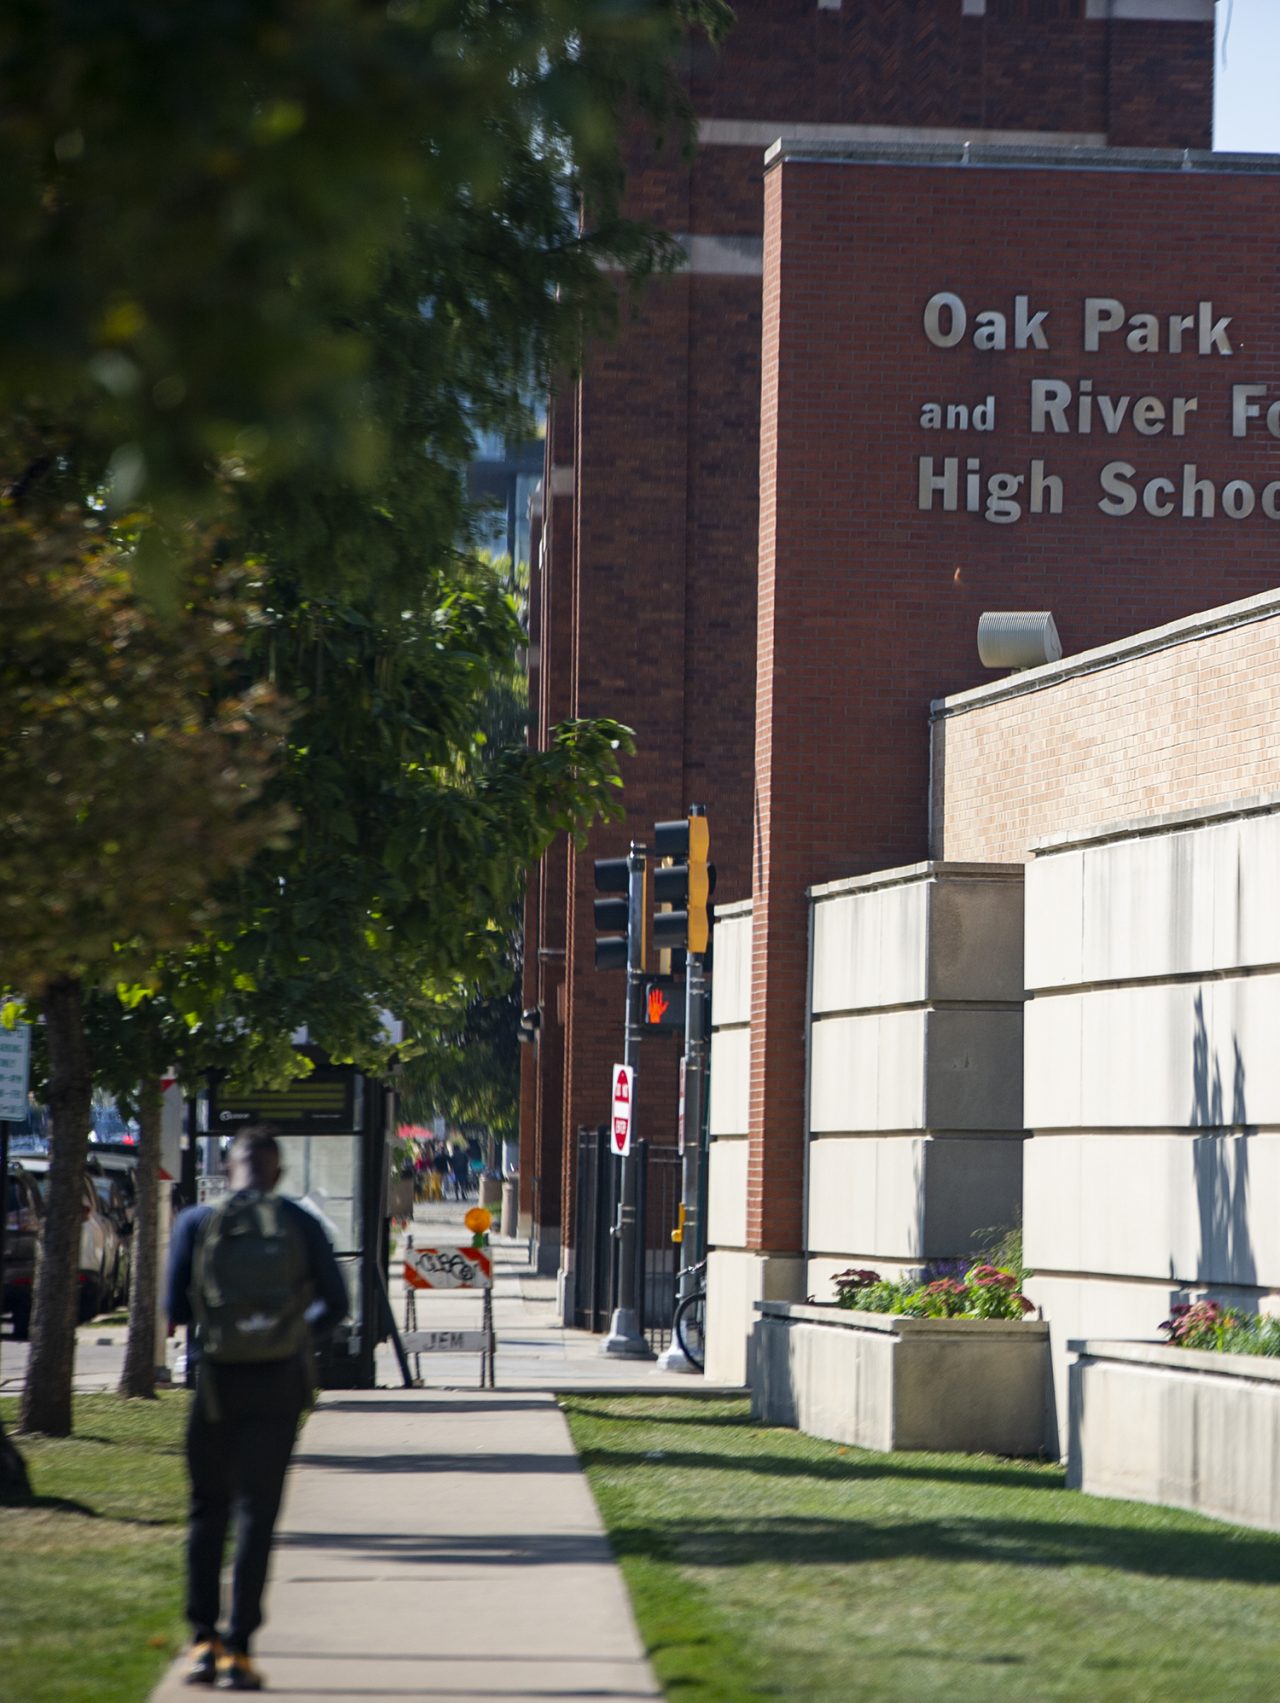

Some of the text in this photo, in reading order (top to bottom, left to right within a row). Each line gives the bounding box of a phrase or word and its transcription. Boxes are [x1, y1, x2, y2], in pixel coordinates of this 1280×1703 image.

[922, 291, 1233, 356] Oak Park
[919, 396, 996, 431] and
[1030, 379, 1198, 437] River
[917, 456, 1064, 524] High
